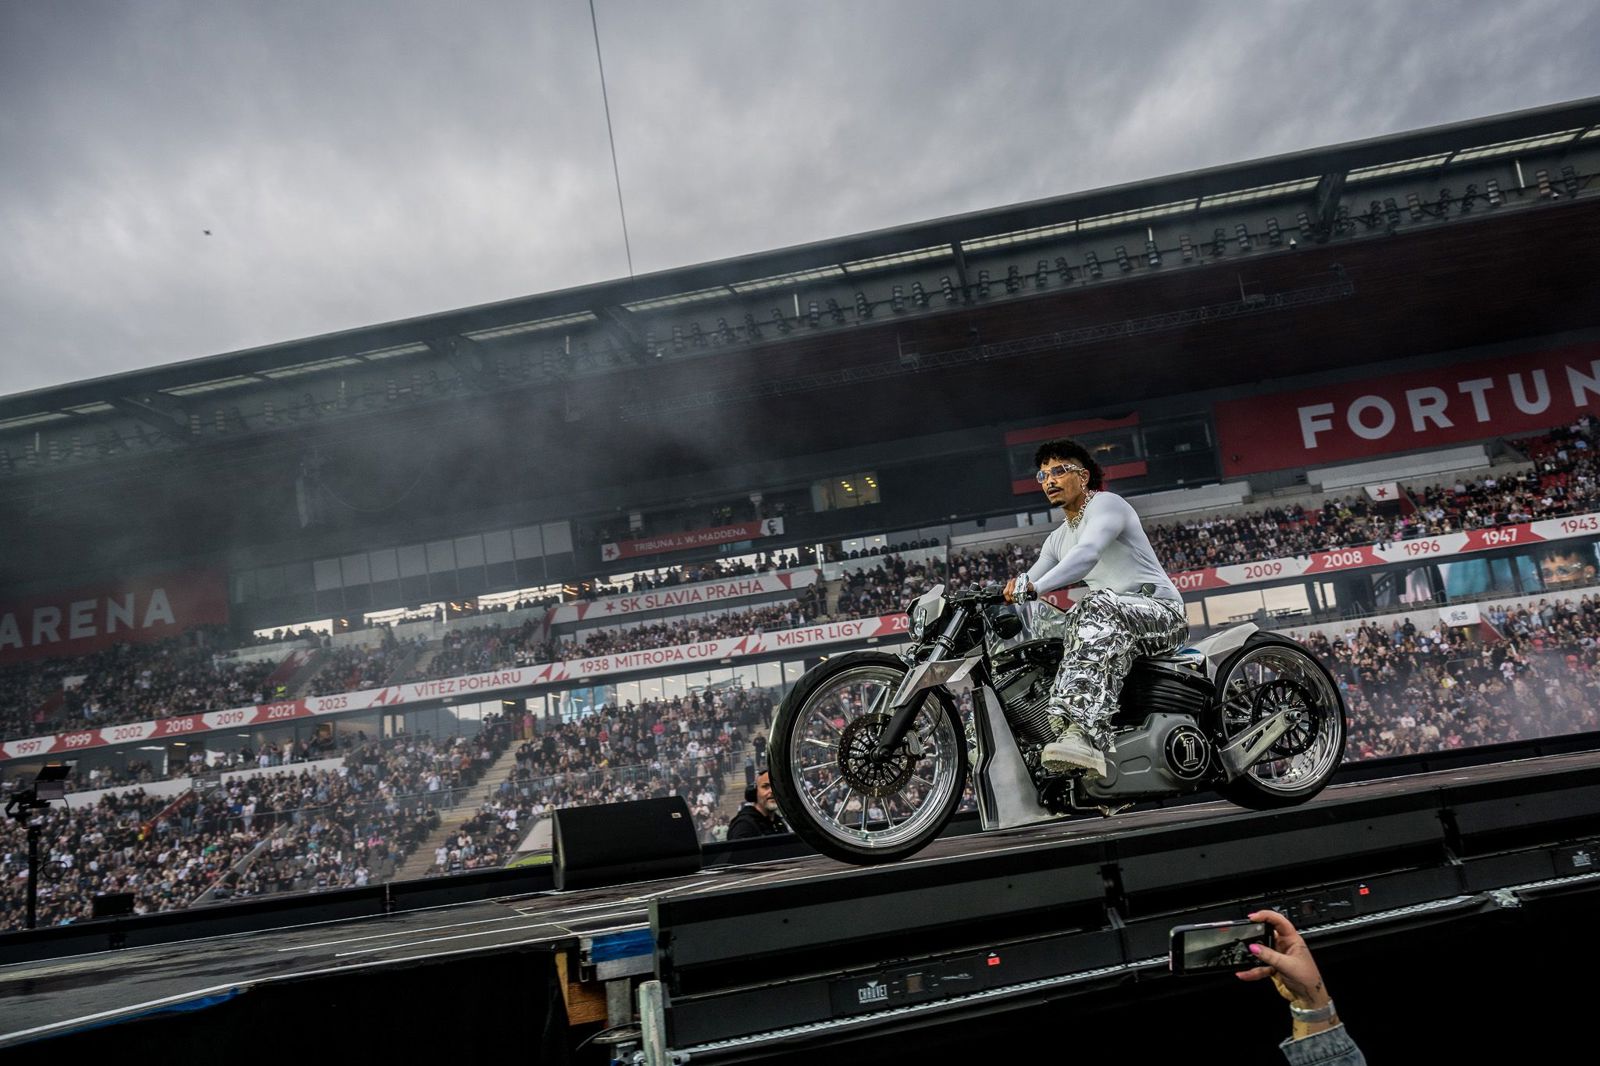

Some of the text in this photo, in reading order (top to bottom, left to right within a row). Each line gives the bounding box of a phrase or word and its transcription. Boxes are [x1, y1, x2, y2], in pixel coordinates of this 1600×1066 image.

[1298, 360, 1600, 449] FORTUN
[1561, 517, 1598, 533] 1943
[634, 539, 674, 551] TRIBUNA
[699, 528, 747, 542] MADDENA
[1482, 528, 1517, 545] 1947
[1404, 540, 1440, 556] 1996
[1322, 551, 1363, 568] 2008
[1244, 562, 1282, 579] 2009
[620, 580, 764, 613] SK SLAVIA PRAHA
[0, 588, 175, 650] ARENA
[776, 622, 863, 646] MISTR LIGY
[580, 643, 718, 673] 1938 MITROPA CUP
[267, 704, 295, 718] 2021
[318, 697, 348, 711] 2023
[165, 718, 193, 733] 2018
[216, 711, 244, 726] 2019
[64, 733, 92, 747] 1999
[114, 726, 143, 740] 2002
[16, 740, 42, 754] 1997
